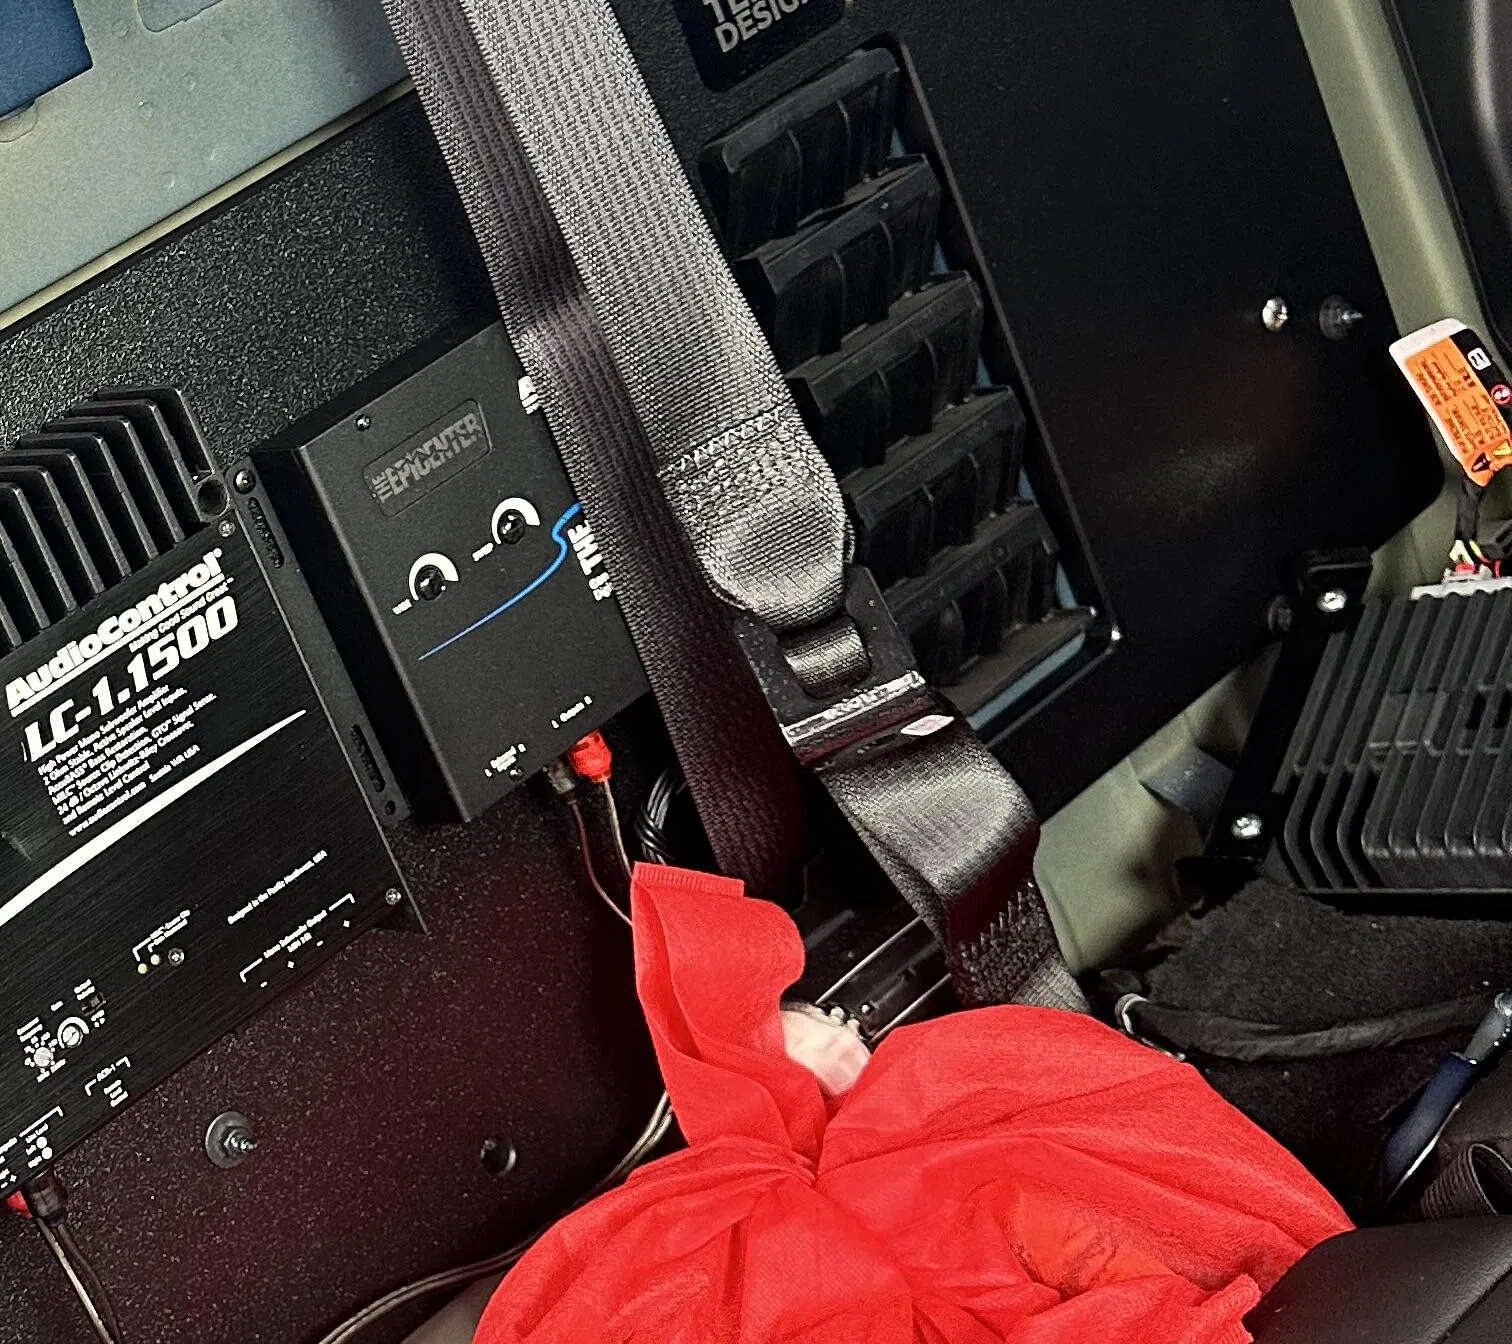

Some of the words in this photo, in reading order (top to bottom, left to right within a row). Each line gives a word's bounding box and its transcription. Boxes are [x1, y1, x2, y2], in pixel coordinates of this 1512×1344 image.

[379, 412, 488, 494] EPICENTER
[22, 596, 237, 760] LC-1.1500
[54, 744, 78, 763] Power
